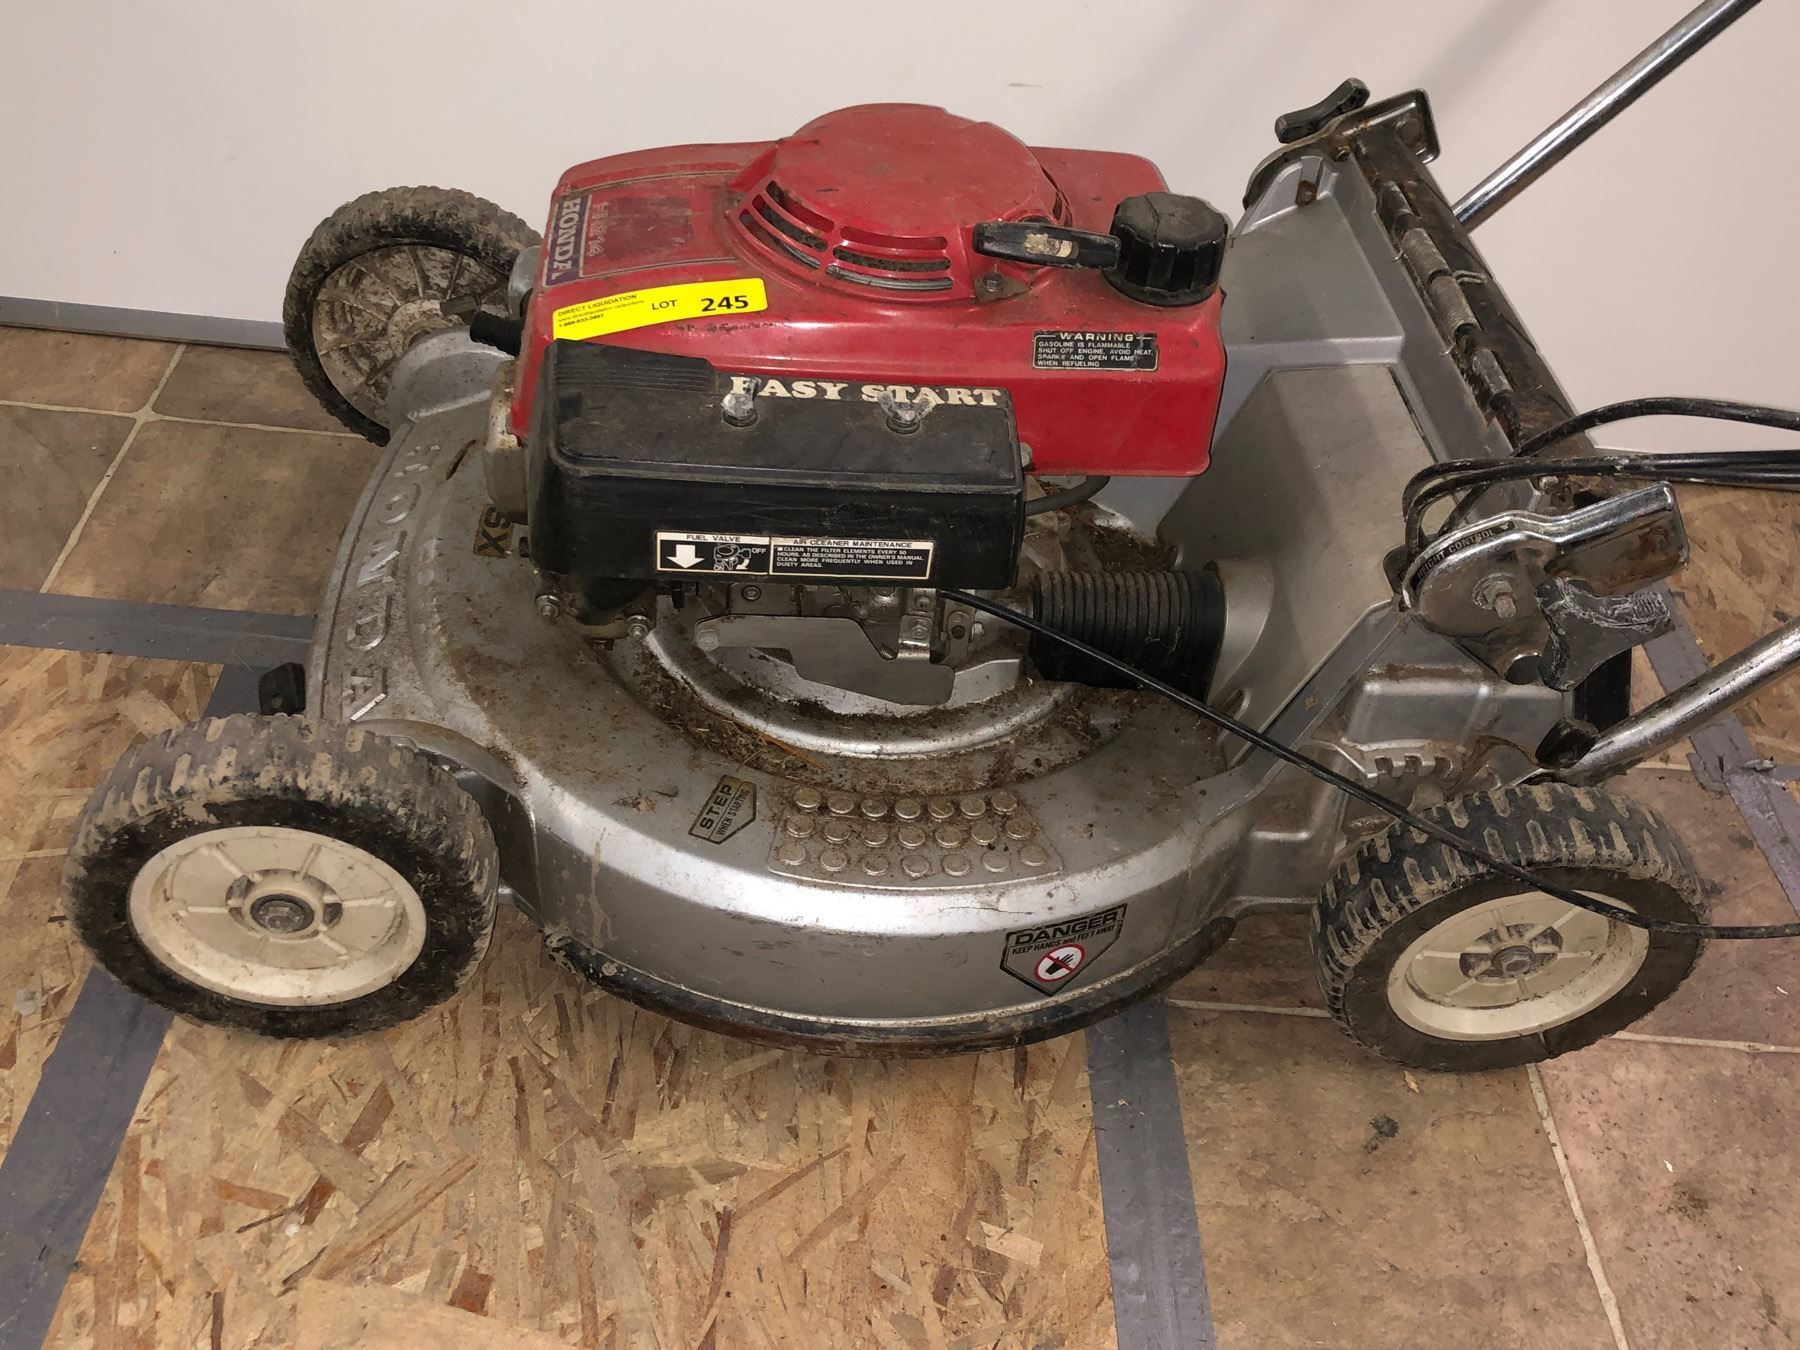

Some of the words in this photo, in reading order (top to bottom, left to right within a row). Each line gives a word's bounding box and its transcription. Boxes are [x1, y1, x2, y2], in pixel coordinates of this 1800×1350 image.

[552, 197, 581, 280] HONDA
[557, 304, 587, 317] DIRECT
[588, 294, 637, 310] LIQUIDATION
[651, 299, 678, 311] LOT
[701, 295, 749, 312] 245
[1060, 332, 1134, 342] WARNING
[731, 376, 848, 400] EASY
[861, 384, 1002, 407] START
[1448, 529, 1496, 554] CONTROL
[700, 785, 732, 829] STEP
[716, 816, 734, 835] WHEN
[727, 789, 750, 816] STARTING
[1012, 945, 1034, 954] KEEP
[1034, 940, 1061, 951] HANDS
[1061, 936, 1076, 944] and
[1077, 931, 1095, 941] FEET
[1096, 925, 1116, 935] AWAY
[1015, 911, 1119, 945] DANGER
